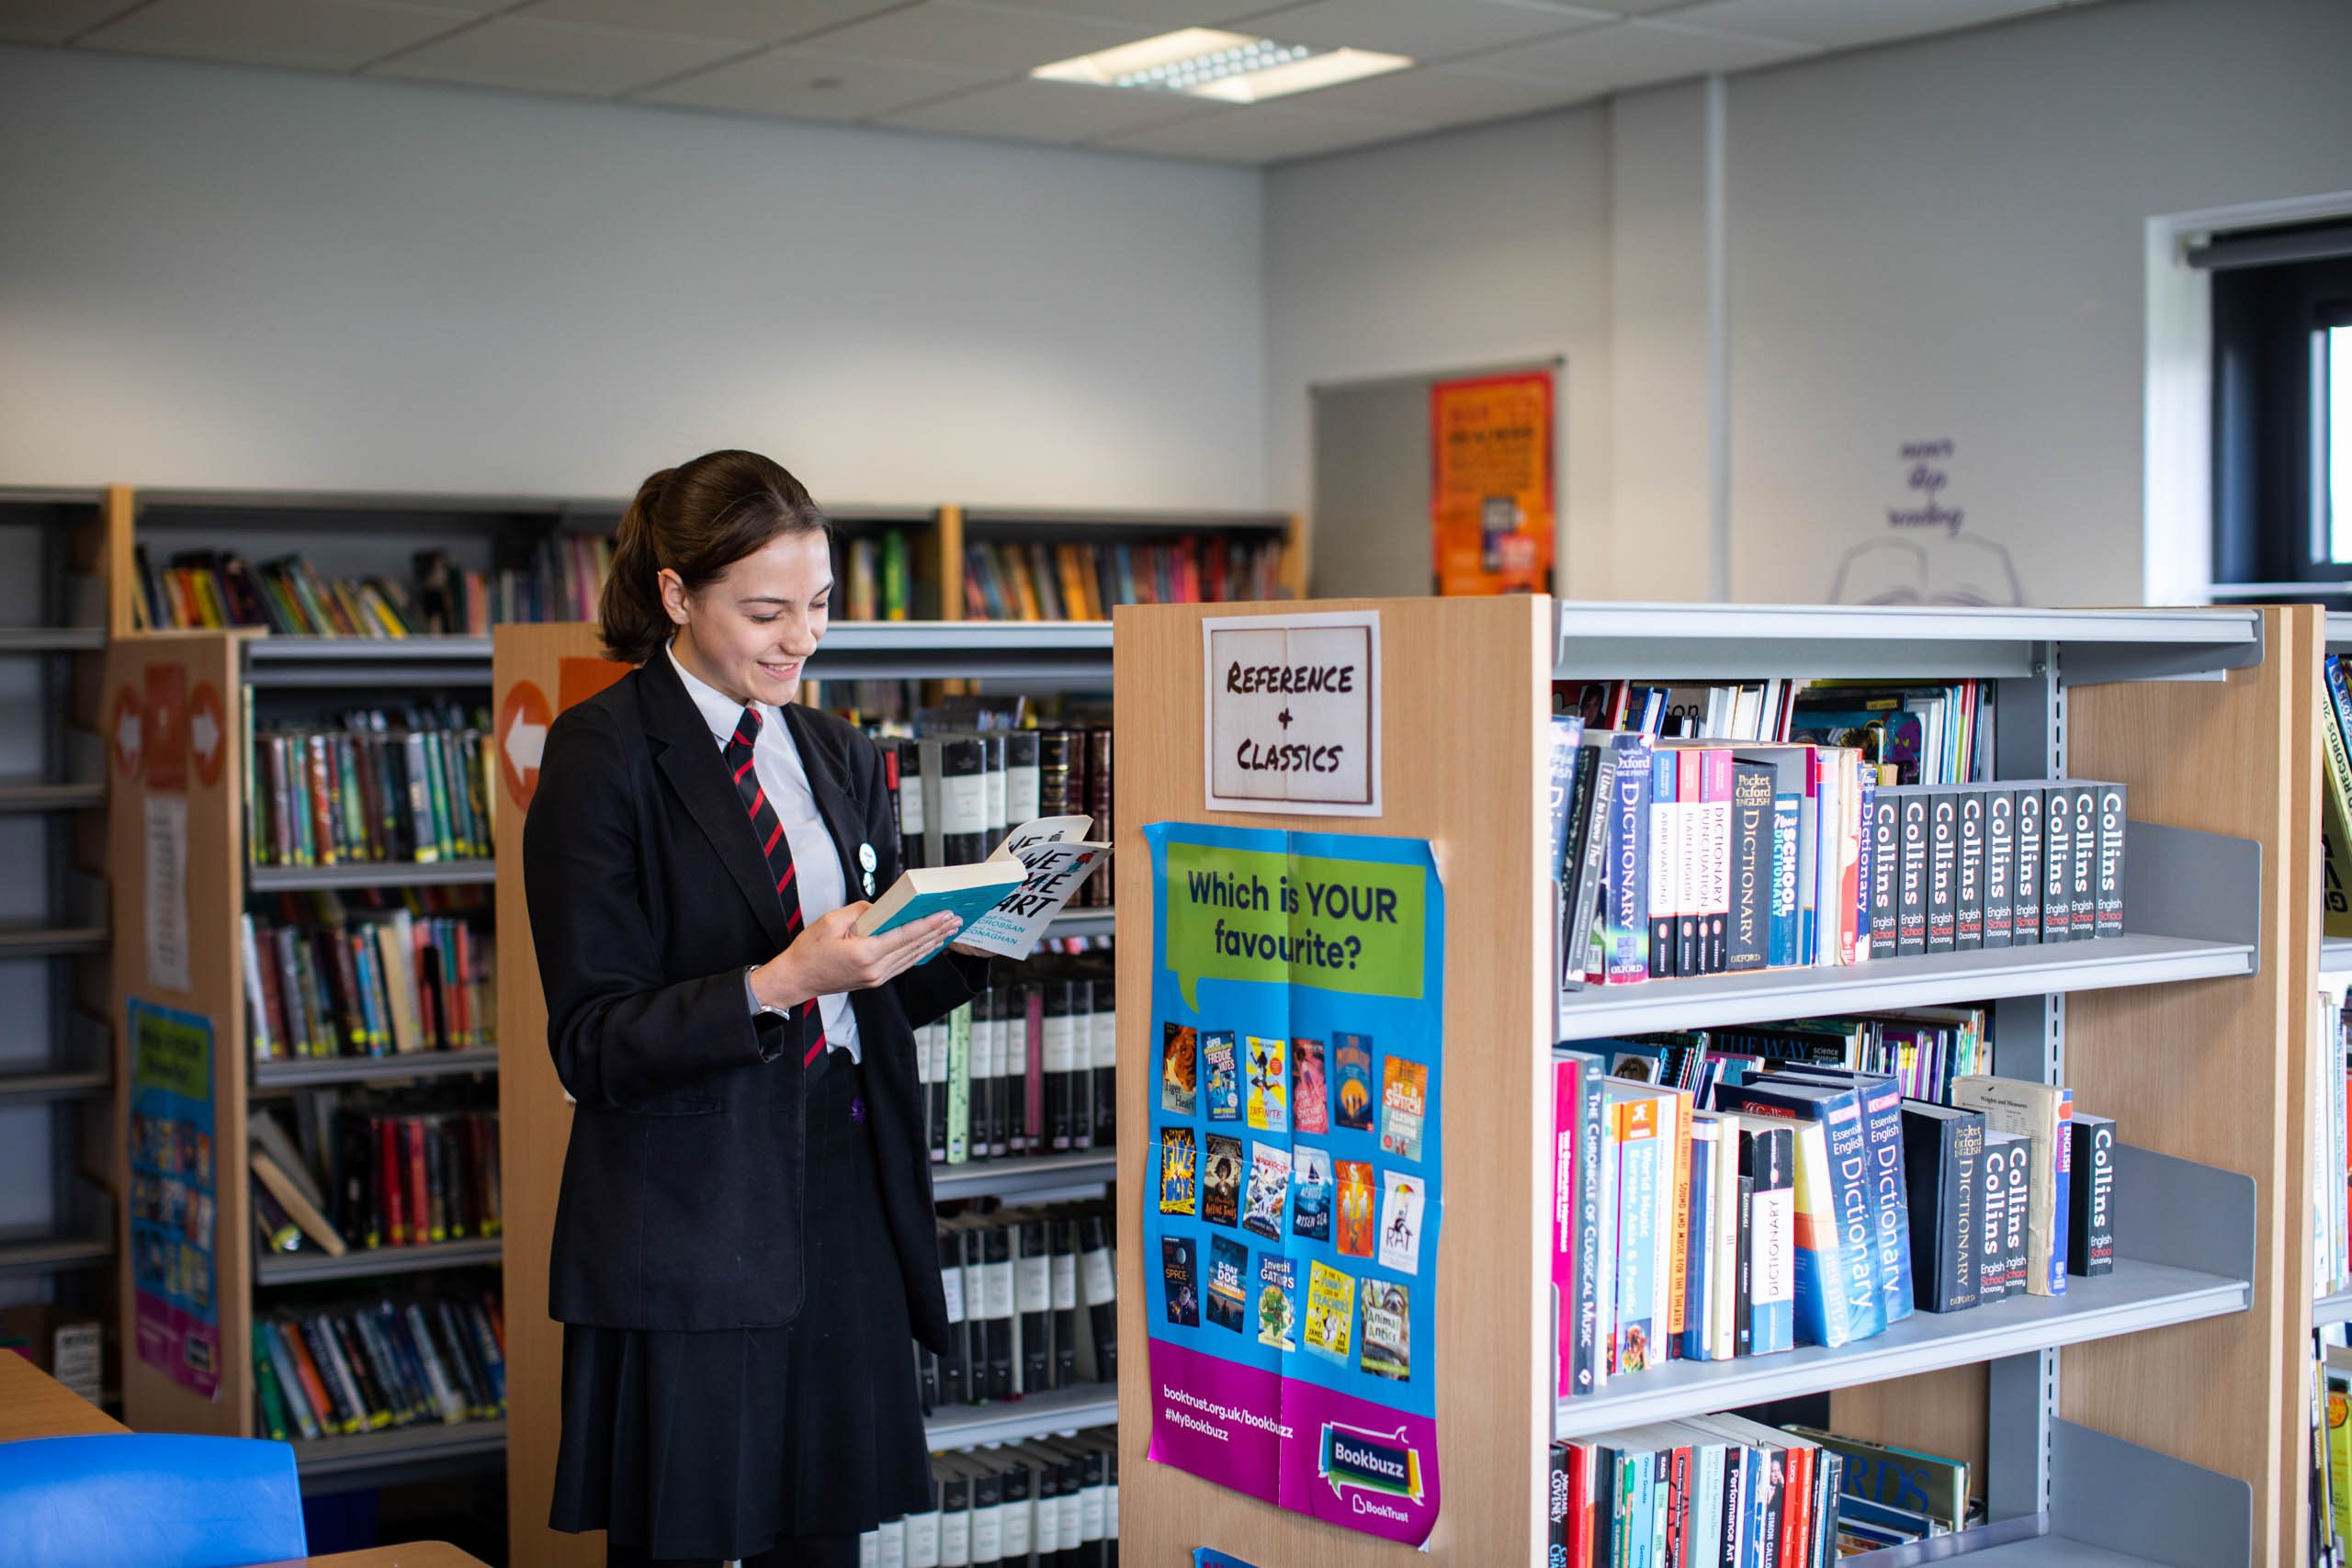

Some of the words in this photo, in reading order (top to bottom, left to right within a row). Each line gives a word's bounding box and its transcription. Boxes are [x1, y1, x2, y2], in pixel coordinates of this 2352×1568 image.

[1227, 661, 1355, 694] REFERENCE
[1237, 739, 1343, 773] CLASSICS
[2327, 722, 2352, 793] RECORDS
[1736, 785, 1771, 797] Oxford
[1739, 773, 1770, 786] Pocket
[1736, 798, 1770, 807] ENGLISH
[1905, 801, 1926, 906] Collins
[1934, 802, 1955, 905] Collins
[1962, 798, 1982, 902] Collins
[1991, 796, 2011, 899] Collins
[2019, 795, 2040, 897] Collins
[2049, 795, 2069, 896] Collins
[2075, 793, 2095, 893] Collins
[2101, 792, 2123, 892] Collins
[1023, 850, 1073, 870] WE
[1621, 782, 1639, 931] DICTIONARY
[1701, 808, 1710, 908] PUNCTUATION
[1713, 807, 1724, 904] DICTIONARY
[1857, 803, 1873, 913] Dictionary
[1876, 803, 1896, 908] Collins
[1740, 809, 1759, 945] DICTIONARY
[1772, 829, 1784, 917] DICTIONARY
[1781, 828, 1797, 918] SCHOOL
[1188, 870, 1269, 911] Which
[1281, 875, 1299, 915] is
[1306, 882, 1397, 924] YOUR
[2072, 899, 2094, 912] English
[2098, 898, 2122, 911] English
[1901, 913, 1924, 927] English
[1930, 912, 1953, 926] English
[1959, 908, 1981, 922] English
[1987, 906, 2011, 919] English
[2017, 904, 2039, 917] English
[2046, 902, 2068, 916] English
[2072, 912, 2094, 922] School
[2098, 911, 2122, 921] School
[1872, 916, 1895, 930] English
[1901, 927, 1925, 937] School
[1930, 926, 1953, 936] School
[1959, 921, 1981, 932] School
[1987, 919, 2012, 930] School
[2017, 917, 2039, 927] School
[2045, 916, 2069, 926] School
[1216, 919, 1362, 970] favourite?
[1873, 930, 1896, 940] School
[1611, 964, 1644, 974] OXFORD
[1730, 953, 1761, 963] OXFORD
[1763, 1036, 1810, 1059] WAY
[1813, 1047, 1839, 1056] science
[1588, 1092, 1600, 1120] THE
[1832, 1123, 1861, 1141] Essential
[1871, 1111, 1898, 1130] Essential
[1871, 1124, 1899, 1143] English
[1833, 1135, 1864, 1156] English
[2063, 1126, 2072, 1172] ENGLISH
[1586, 1123, 1600, 1200] CHRONICLE
[1165, 1178, 1191, 1201] BOY
[2093, 1129, 2112, 1228] Collins
[1984, 1153, 2005, 1255] Collins
[2007, 1147, 2028, 1249] Collins
[1316, 1213, 1328, 1226] SEA
[1585, 1203, 1596, 1222] OF
[1878, 1145, 1900, 1292] Dictionary
[1957, 1158, 1973, 1287] DICTIONARY
[1385, 1226, 1412, 1251] RAT
[1841, 1156, 1874, 1308] Dictionary
[2090, 1234, 2112, 1247] English
[1770, 1200, 1780, 1296] DICTIONARY
[2090, 1247, 2112, 1258] School
[1582, 1226, 1597, 1298] CLASSICAL
[1981, 1261, 2005, 1276] English
[1217, 1270, 1238, 1285] DOG
[1981, 1275, 2005, 1286] School
[1368, 1309, 1400, 1330] Animal
[1581, 1302, 1596, 1348] MUSIC
[1369, 1325, 1396, 1342] Antics
[1163, 1383, 1294, 1438] booktrust.org.uk/bookbuzz
[1165, 1407, 1229, 1441] #MyBookbuzz
[1335, 1441, 1405, 1478] Bookbuzz
[1550, 1469, 1563, 1524] COVENEY
[1727, 1469, 1739, 1542] Performance
[1366, 1500, 1409, 1523] BookTrust
[1767, 1511, 1776, 1540] SIMON
[1726, 1543, 1736, 1562] Art
